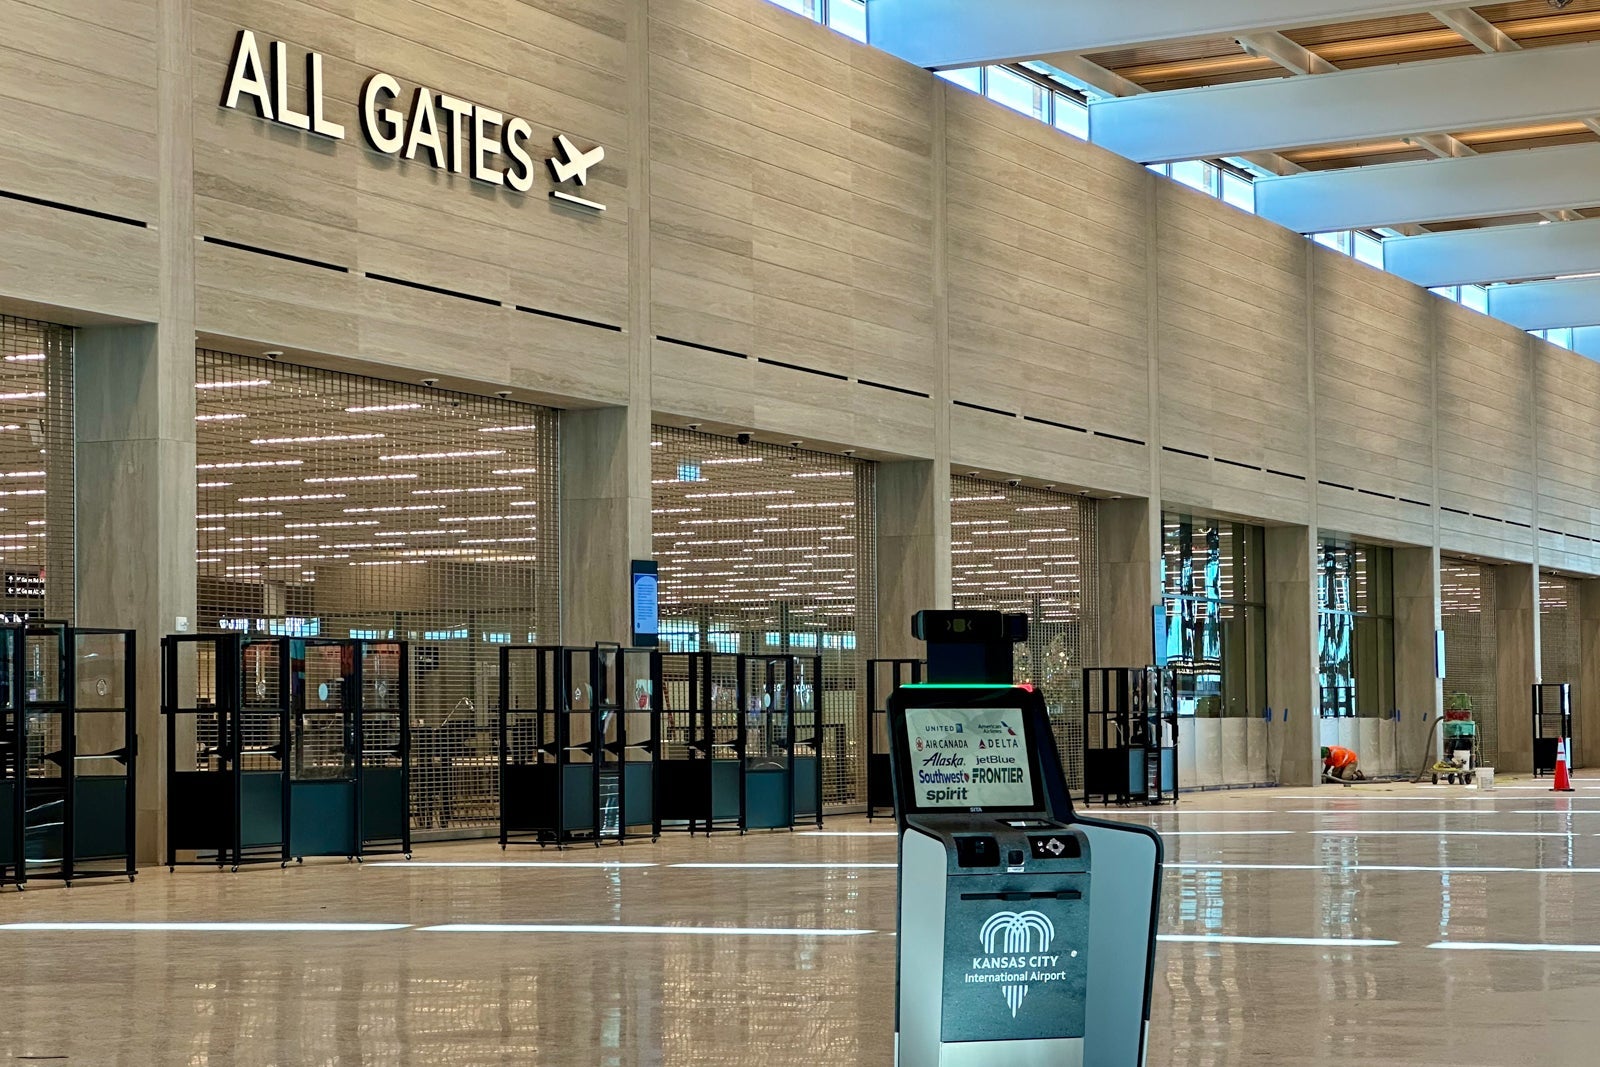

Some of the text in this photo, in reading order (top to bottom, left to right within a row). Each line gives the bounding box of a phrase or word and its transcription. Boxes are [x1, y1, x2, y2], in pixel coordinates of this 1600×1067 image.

[221, 29, 534, 192] ALL GATES
[925, 739, 969, 749] AIR CANADA
[988, 738, 1018, 748] DELTA
[976, 755, 1015, 765] jetBlue
[918, 769, 964, 784] Southwest
[972, 767, 1024, 784] FRONTIER
[926, 786, 968, 803] spirit
[973, 955, 1059, 969] KANSAS CITY
[965, 971, 1066, 983] International Airport
